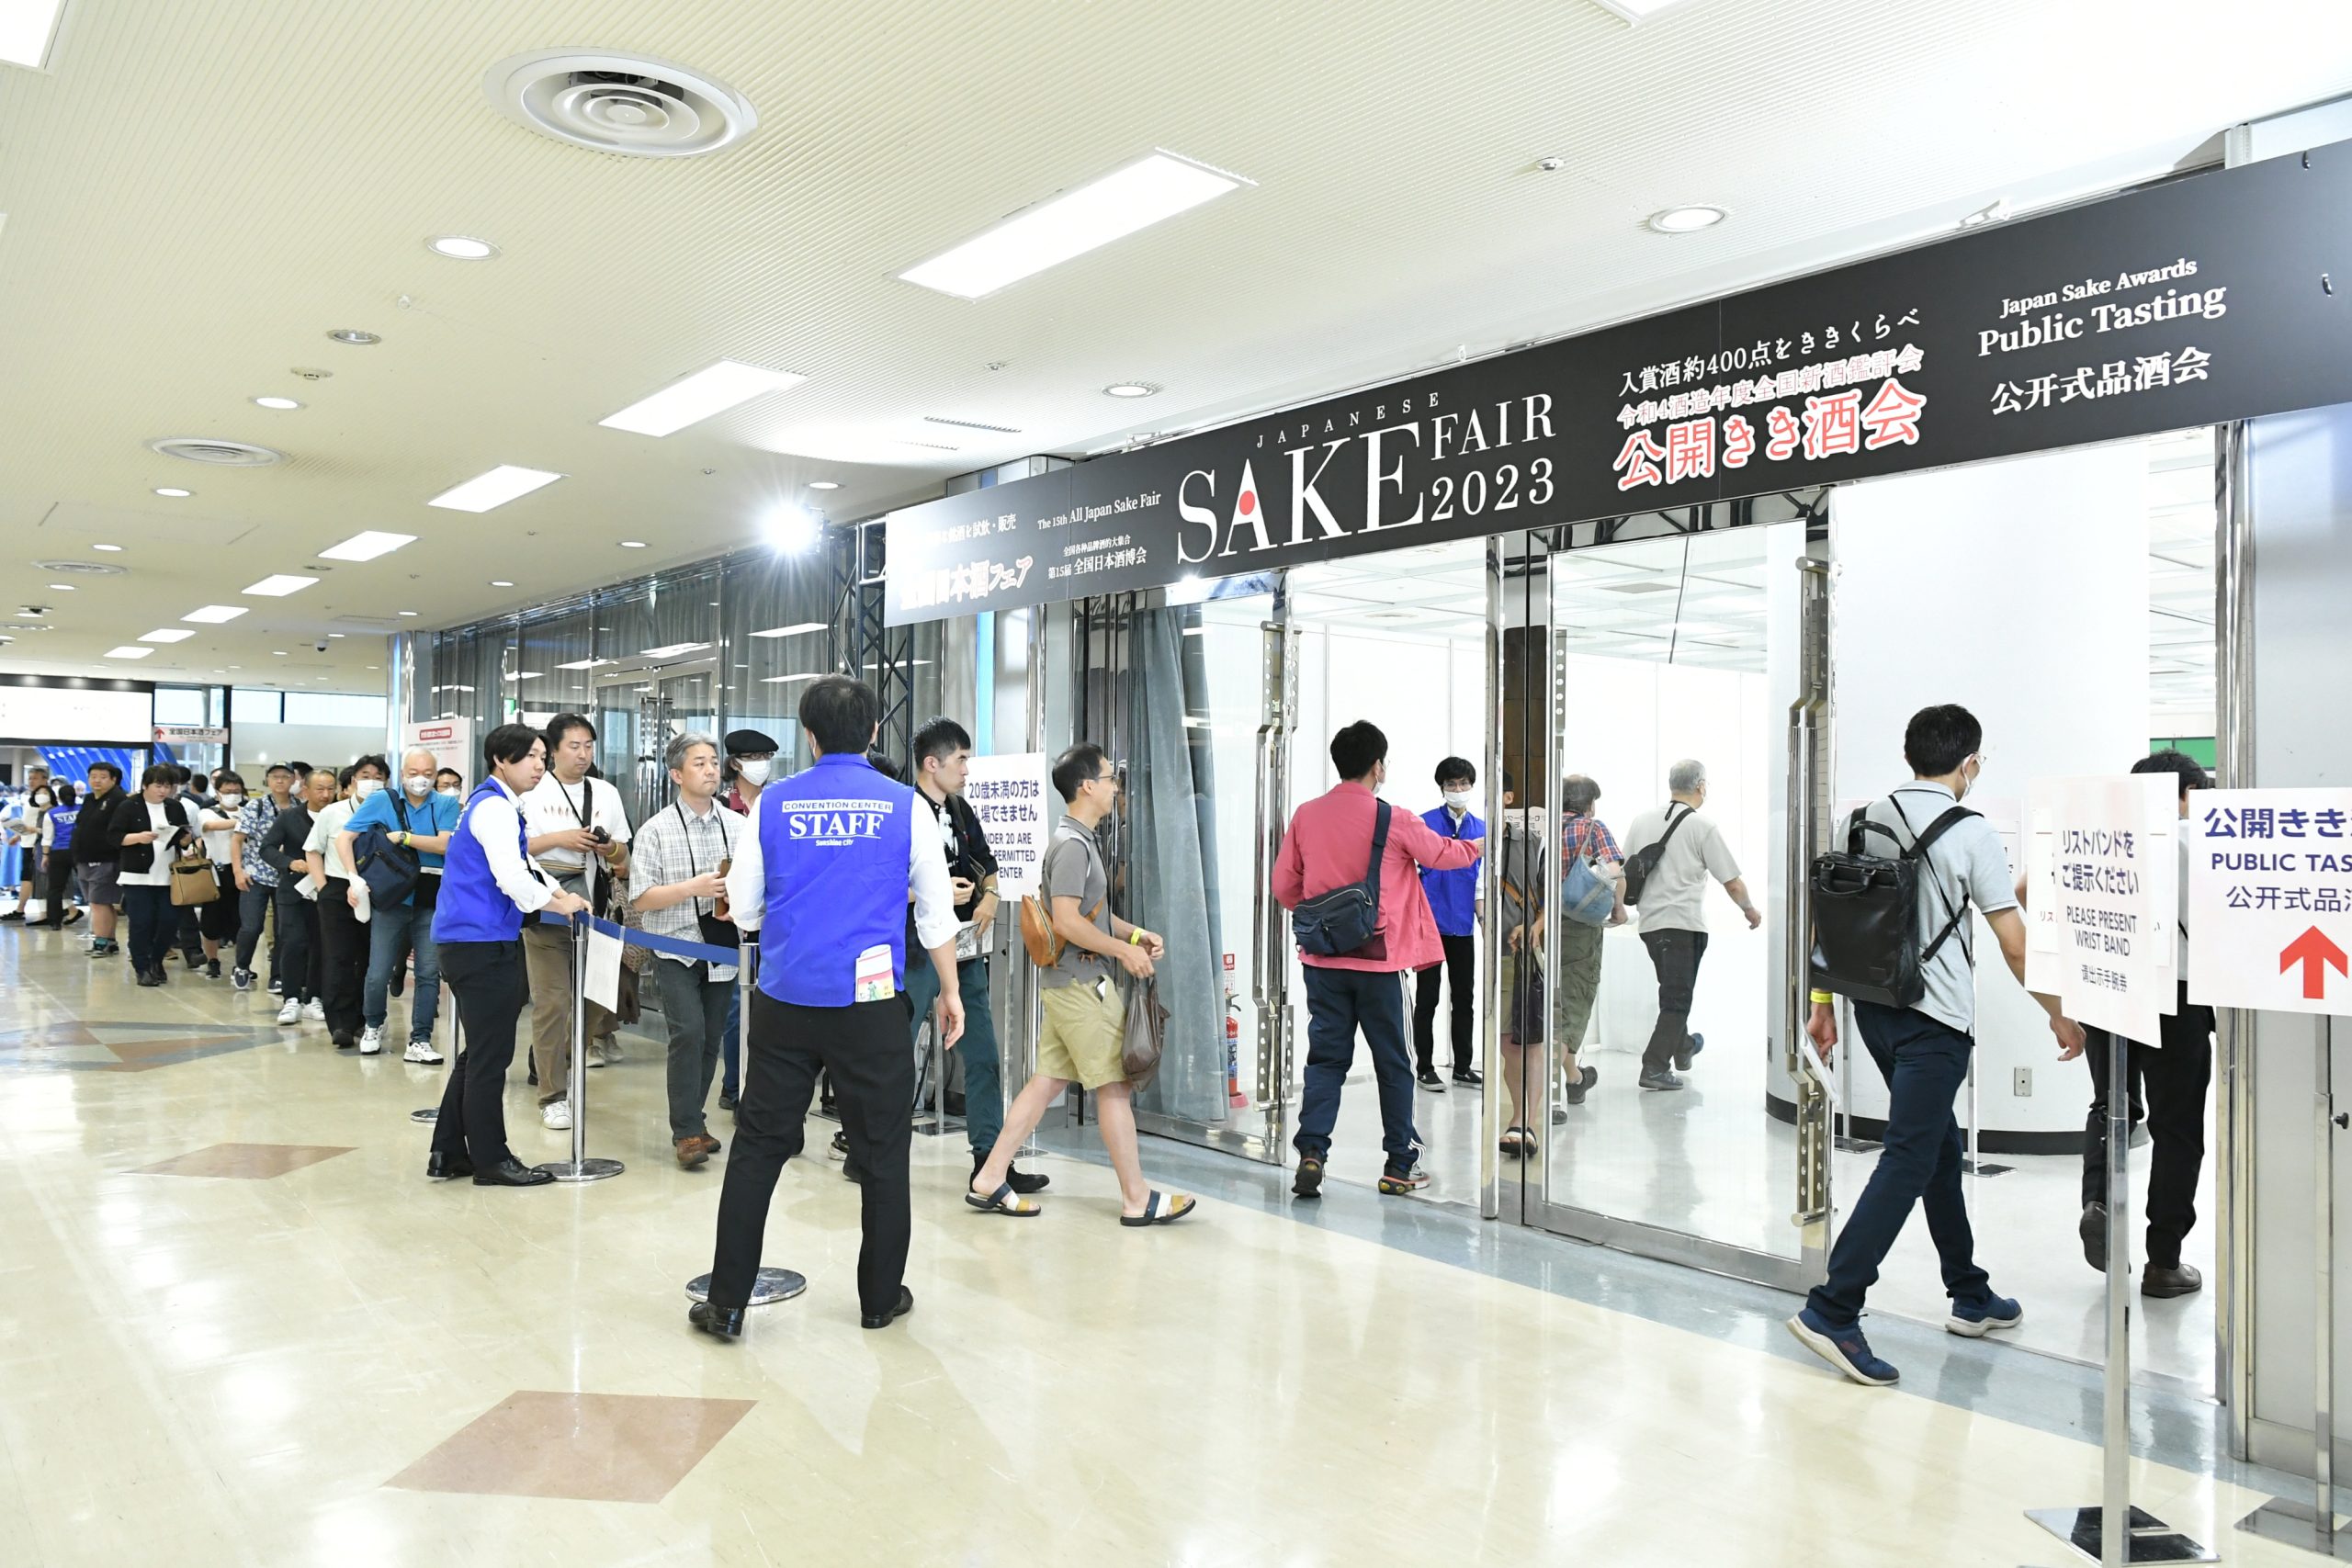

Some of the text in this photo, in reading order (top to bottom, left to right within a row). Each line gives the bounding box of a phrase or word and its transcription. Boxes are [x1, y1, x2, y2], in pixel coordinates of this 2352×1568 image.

[1999, 257, 2198, 319] Japan Sake Awards
[1978, 286, 2227, 357] Public Tasting
[1618, 308, 1921, 397] 入賞酒約400点をききくらべ
[1616, 343, 1925, 430] 令和4酒造年度全国新酒鑑評会
[1990, 346, 2211, 415] 公开式品酒会
[1256, 391, 1440, 448] JAPANESE
[1430, 393, 1556, 461] FAIR
[1613, 378, 1927, 491] 公開きき酒会
[1177, 421, 1424, 565] SAKE
[1430, 457, 1555, 522] 2023
[1037, 491, 1161, 530] The 15th All Japan Sake Fair
[1074, 547, 1148, 576] 全国日本酒博会
[968, 779, 1040, 800] 20歳未満の方は
[784, 801, 891, 811] CONVENTION CENTER
[789, 812, 884, 838] STAFF
[984, 832, 1032, 844] NDER 20 ARE
[2204, 807, 2352, 840] 公開きき
[993, 850, 1036, 862] PERMITTED
[2063, 829, 2134, 859] リストバンドを
[1000, 866, 1023, 878] ENTER
[2211, 852, 2296, 872] PUBLIC
[2063, 863, 2140, 895] ご提示ください
[2066, 905, 2097, 927] PLEASE
[2098, 909, 2137, 934] PRESENT
[2075, 929, 2131, 956] WRIST BAND
